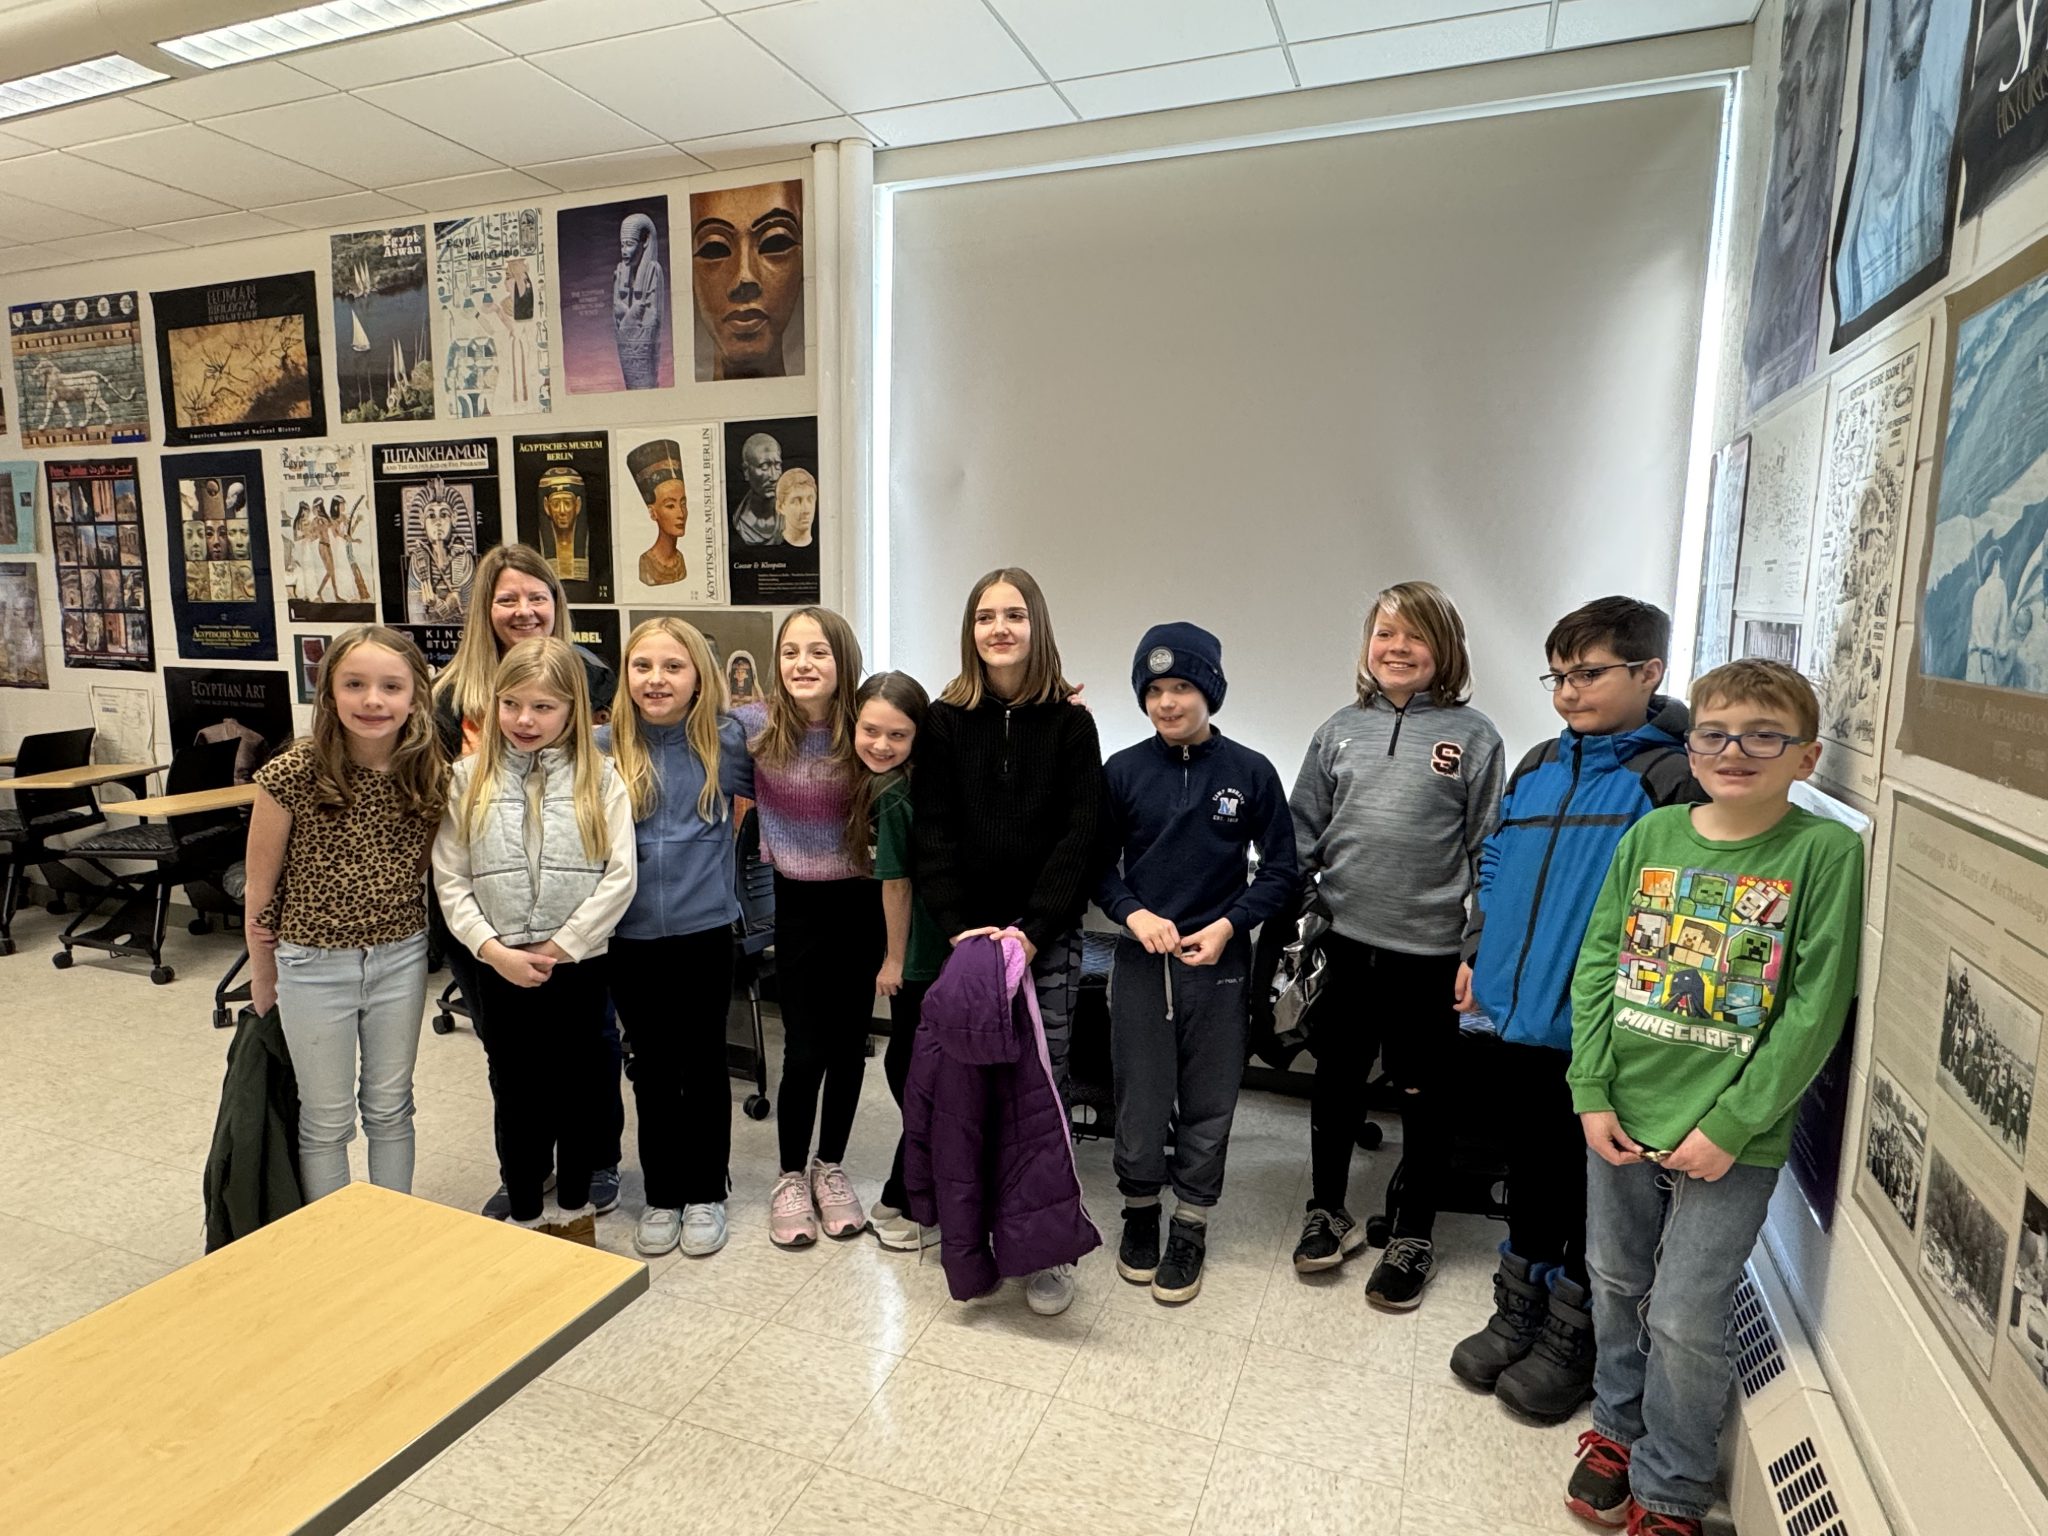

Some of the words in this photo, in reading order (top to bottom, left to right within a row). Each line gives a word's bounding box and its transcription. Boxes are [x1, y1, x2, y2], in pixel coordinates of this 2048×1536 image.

[383, 231, 420, 247] Egypt
[446, 237, 475, 248] Egypt
[383, 244, 422, 257] Aswan
[207, 284, 256, 305] HUMAN
[381, 443, 488, 463] TUTANKHAMUN
[519, 442, 568, 452] ÄGYPTISCHES
[568, 440, 602, 449] MUSEUM
[702, 428, 711, 469] BERLIN
[283, 460, 308, 469] Egypt
[546, 452, 573, 461] BERLIN
[703, 473, 712, 524] MUSEUM
[704, 527, 716, 599] ÄGYPTISCHES
[426, 630, 464, 639] KING
[433, 640, 458, 649] TUT
[191, 680, 242, 697] EGYPTIAN
[245, 683, 266, 699] ART
[1431, 741, 1464, 780] S
[1218, 797, 1239, 816] M
[1616, 1007, 1753, 1055] MINECRAFT
